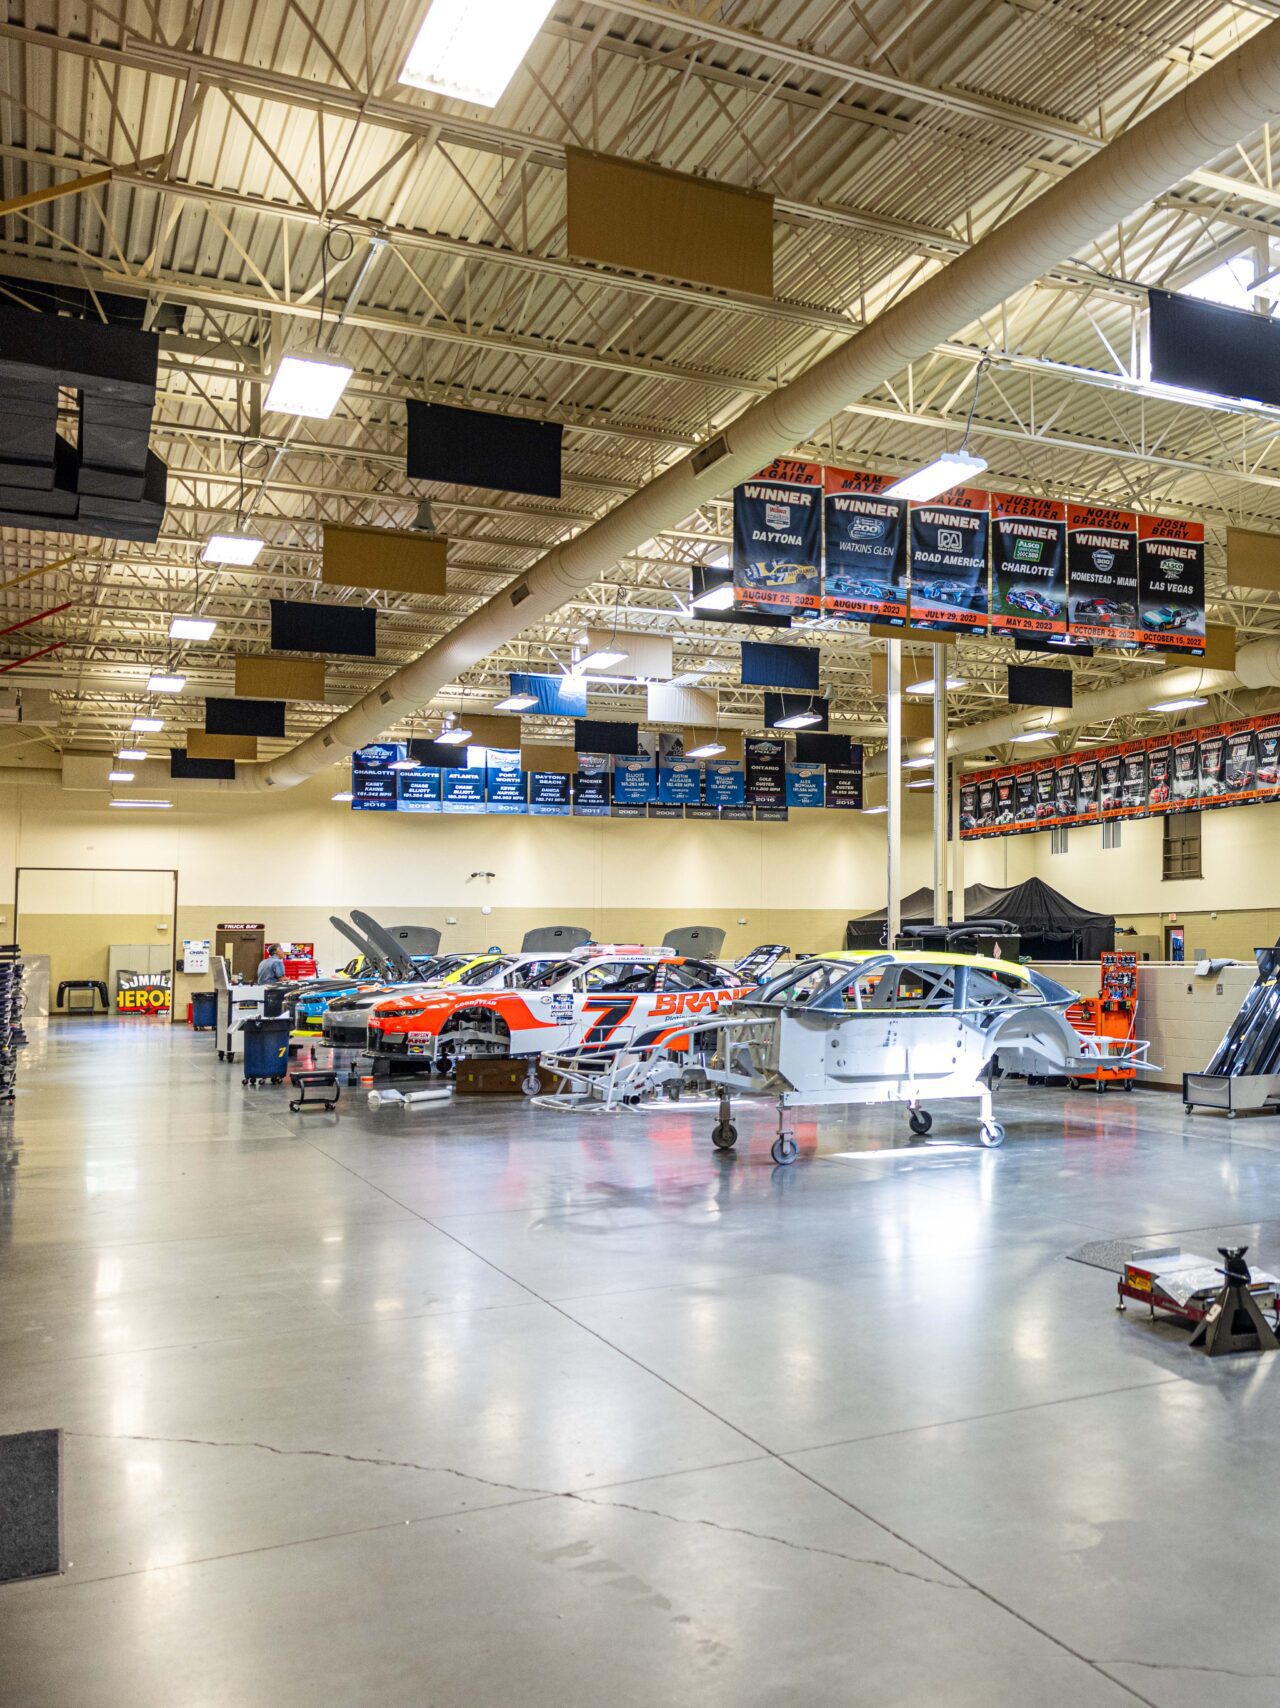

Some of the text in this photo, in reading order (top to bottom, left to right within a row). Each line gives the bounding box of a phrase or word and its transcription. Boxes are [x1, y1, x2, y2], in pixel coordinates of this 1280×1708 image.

[771, 459, 808, 473] STIN
[761, 469, 814, 483] LGAIER
[854, 472, 882, 483] SAM
[842, 480, 885, 492] MAYE
[744, 485, 812, 506] WINNER
[1006, 496, 1052, 509] JUSTIN
[835, 498, 899, 517] WINNER
[996, 503, 1059, 519] ALLGAIER
[1086, 508, 1120, 520] NOAH
[920, 511, 980, 530] WINNER
[1073, 516, 1130, 530] GRAGSON
[1157, 519, 1188, 530] JOSH
[853, 524, 878, 533] 200
[1000, 522, 1058, 540] WINNER
[1152, 526, 1189, 539] BERRY
[752, 531, 802, 545] DAYTONA
[1076, 533, 1129, 550] WINNER
[840, 542, 894, 556] WATKINS GLEN
[1146, 542, 1197, 560] WINNER
[914, 551, 985, 568] ROAD AMERICA
[1001, 562, 1055, 576] CHARLOTTE
[1071, 571, 1112, 584] HOMESTEAD
[1117, 578, 1137, 587] MIAMI
[1150, 581, 1193, 594] LAS VEGAS
[743, 590, 814, 606] AUGUST 25, 2023
[834, 600, 900, 614] AUGUST 19, 2023
[925, 611, 977, 622] JULY 29, 2023
[1006, 618, 1052, 630] MAY 29, 2023
[1144, 633, 1201, 646] OCTOBER 15, 2022
[454, 999, 497, 1008] GOODYEAR
[648, 988, 757, 1016] BRAN
[580, 996, 638, 1048] 7
[279, 1048, 286, 1057] 7
[1206, 1304, 1222, 1322] 9
